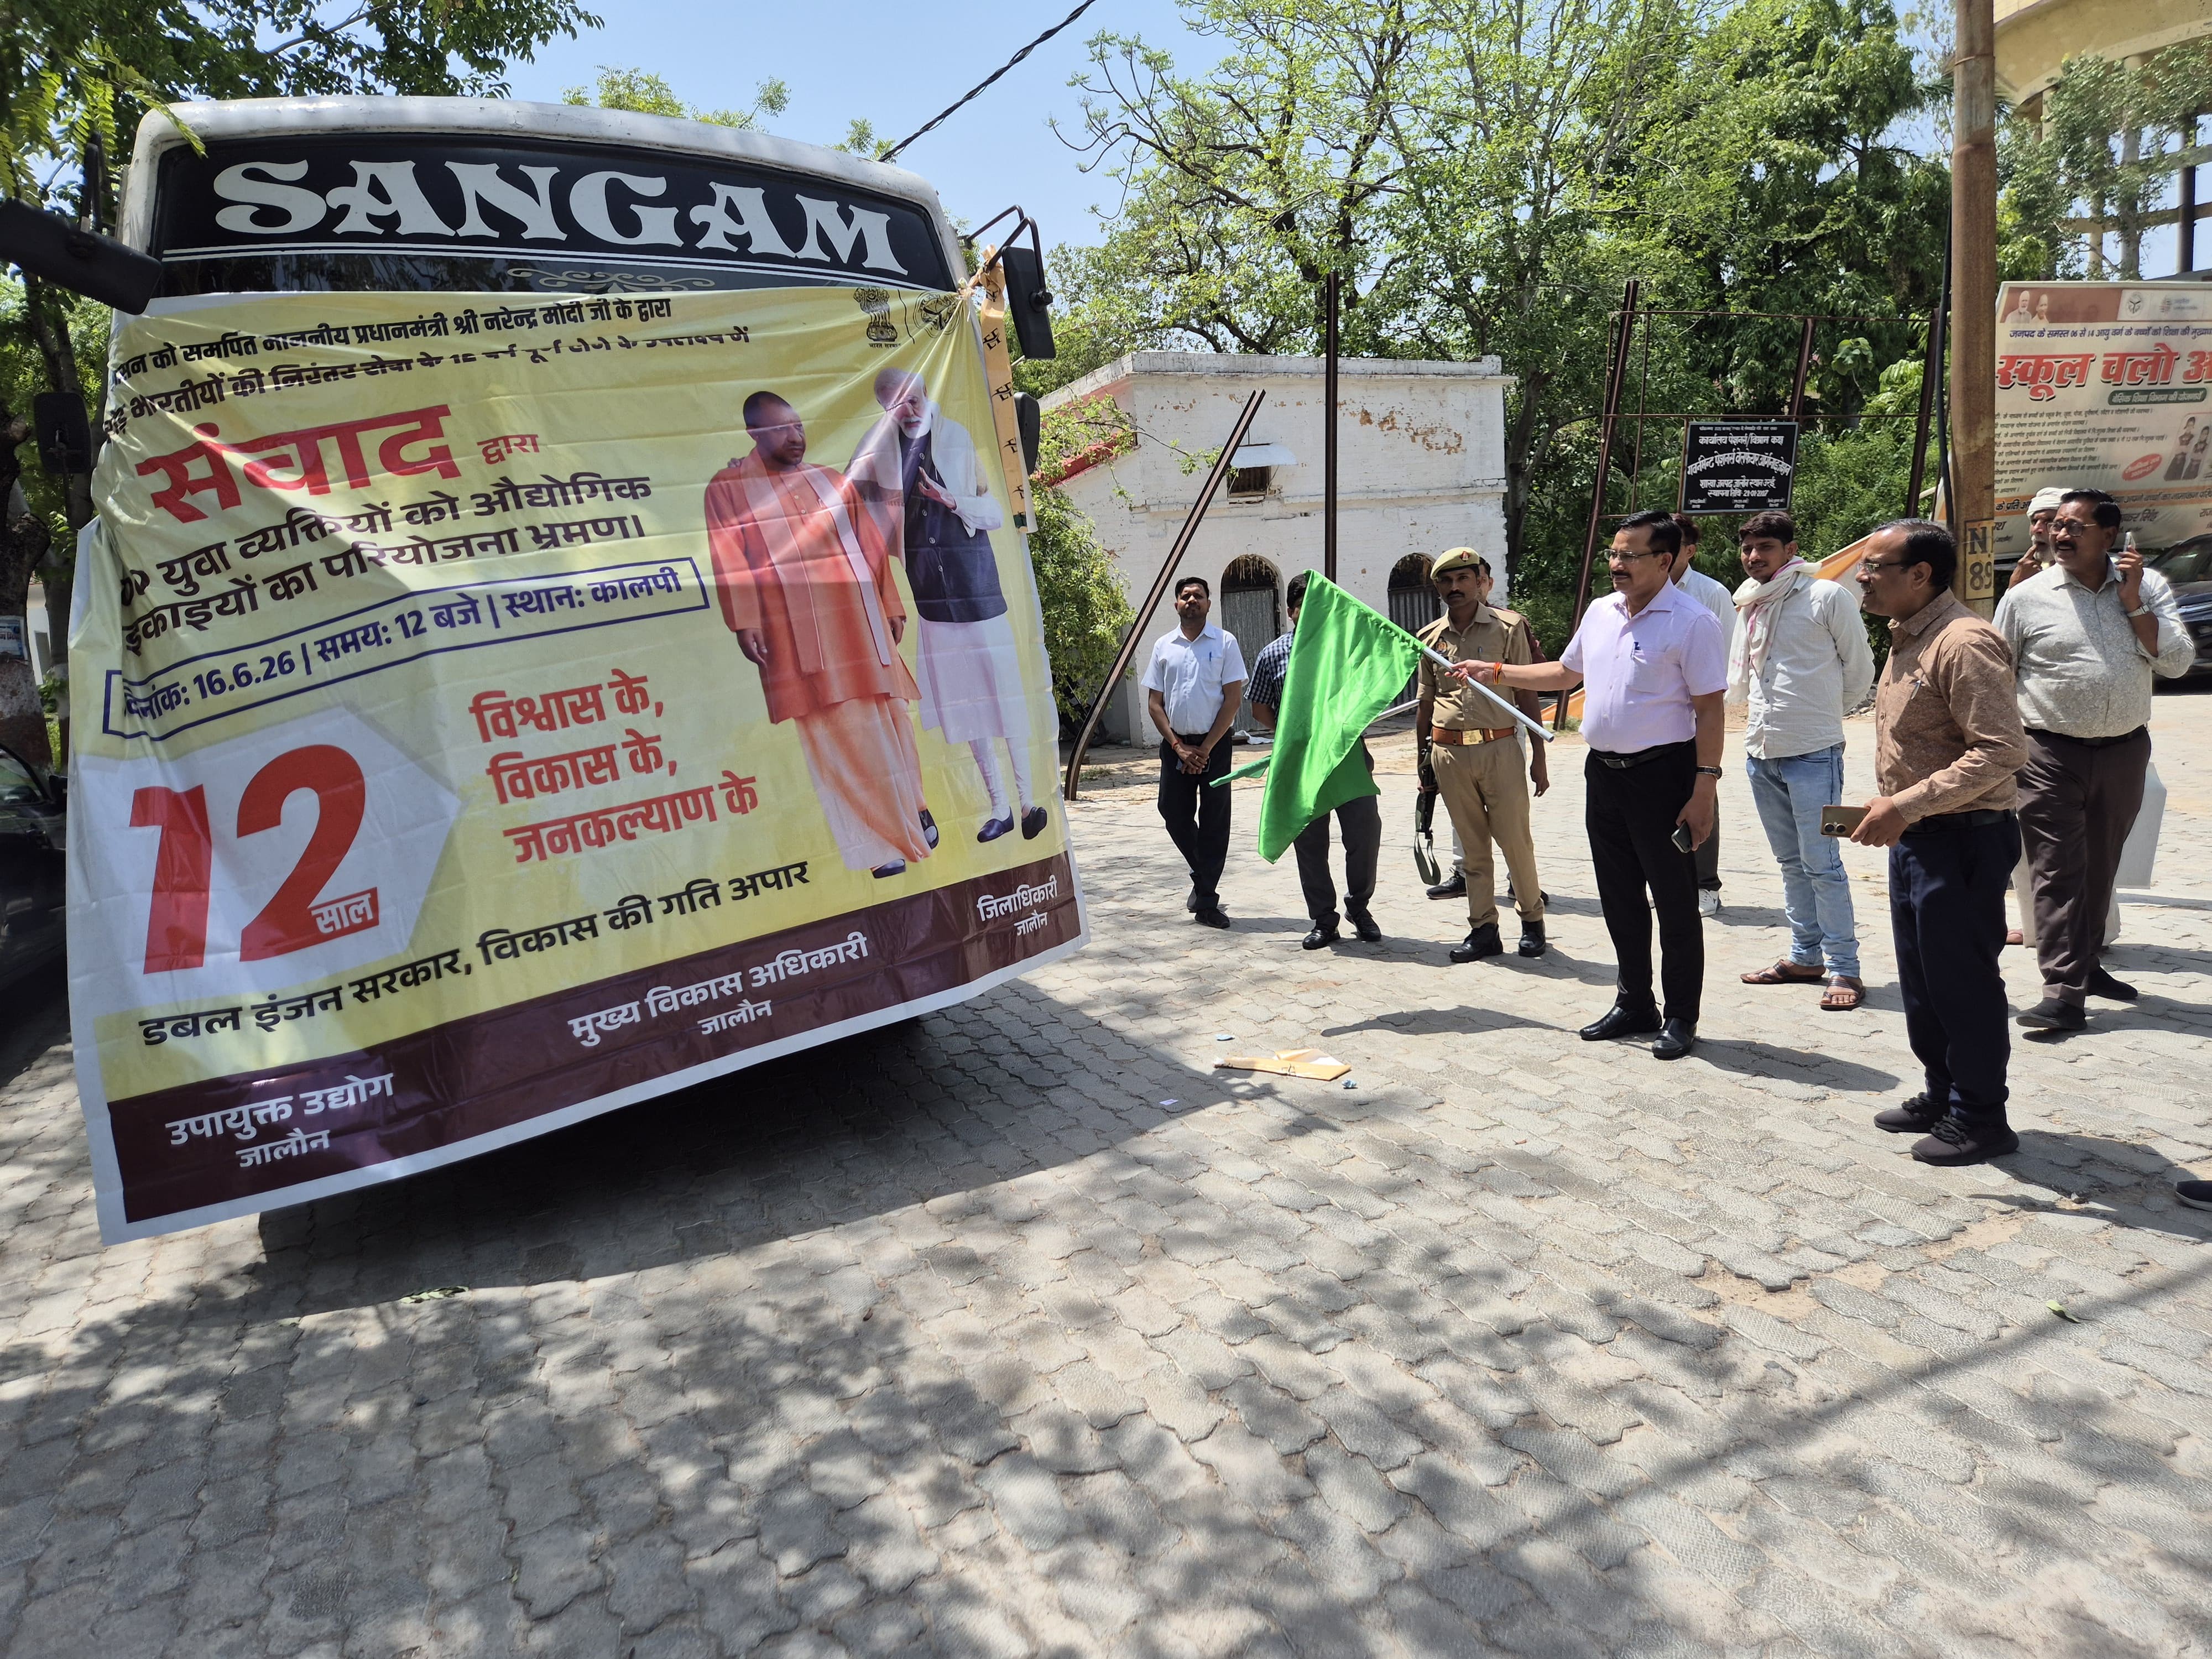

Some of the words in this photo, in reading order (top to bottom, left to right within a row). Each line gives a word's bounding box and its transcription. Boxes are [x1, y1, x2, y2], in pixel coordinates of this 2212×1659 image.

[213, 159, 909, 276] SANGAM
[149, 342, 178, 369] को
[262, 323, 350, 351] माननीय
[352, 312, 449, 343] प्रधानमंत्री
[454, 309, 479, 335] श्री
[481, 305, 536, 332] नरेन्द्र
[541, 301, 584, 326] मोदी
[586, 298, 612, 321] जी
[614, 296, 633, 319] के
[635, 298, 671, 322] द्वारा
[2037, 328, 2046, 337] के
[2047, 330, 2069, 338] समस्त
[2079, 327, 2087, 337] से
[131, 372, 225, 418] भारतीयों
[228, 368, 265, 397] की
[1996, 353, 2096, 401] स्कूल
[2101, 342, 2180, 385] चलो
[135, 404, 462, 523] संवाद
[477, 434, 539, 465] द्वारा
[156, 541, 231, 596] युवा
[234, 502, 393, 559] व्यक्तियों
[400, 491, 460, 526] को
[471, 472, 651, 517] औद्योगिक
[1968, 526, 1994, 555] N
[1995, 500, 2005, 510] के
[2006, 499, 2020, 512] प्रति
[123, 574, 258, 656] इकाइयों
[263, 562, 318, 601] का
[320, 528, 520, 577] परियोजना
[525, 514, 646, 550] भ्रमण।
[194, 650, 296, 699] 16.6.26
[314, 620, 392, 662] समय:
[395, 609, 427, 639] 12
[429, 592, 481, 629] बजे
[502, 584, 585, 618] स्थान:
[587, 566, 683, 603] कालपी
[468, 684, 607, 743] विश्वास
[608, 668, 664, 718] के,
[486, 743, 620, 805] विकास
[622, 728, 678, 777] के,
[503, 785, 718, 864] जनकल्याण
[718, 770, 759, 815] के
[129, 744, 366, 974] 12
[311, 891, 374, 935] साल
[977, 875, 1057, 921] जिलाधिकारी
[1014, 909, 1048, 936] जालौन
[138, 1006, 242, 1046] डबल
[251, 994, 343, 1032] इंजन
[348, 949, 472, 1004] सरकार,
[476, 914, 599, 966] विकास
[603, 894, 654, 930] की
[656, 878, 721, 916] गति
[728, 860, 810, 901] अपार
[567, 999, 640, 1047] मुख्य
[643, 972, 743, 1018] विकास
[749, 931, 868, 988] अधिकारी
[697, 999, 773, 1035] जालौन
[165, 1094, 294, 1146] उपायुक्त
[299, 1072, 394, 1115] उद्योग
[236, 1128, 330, 1168] जालौन
